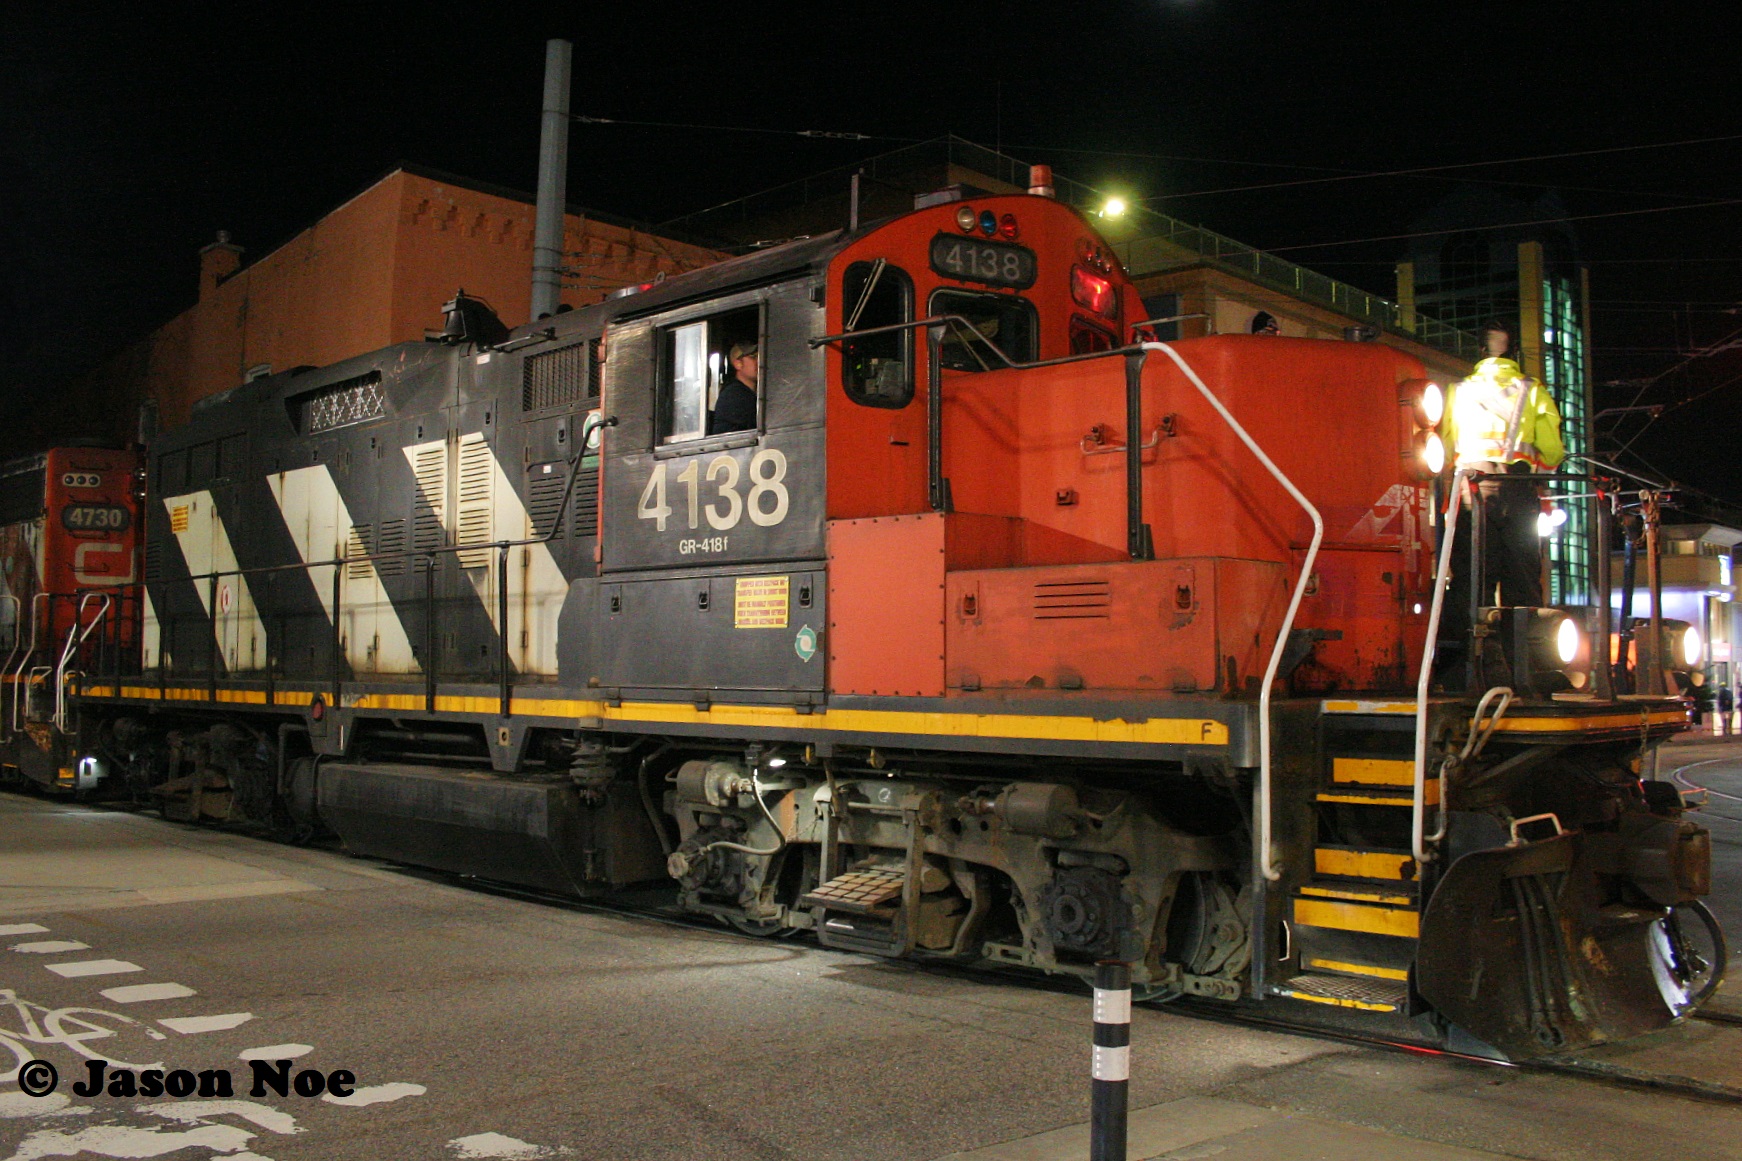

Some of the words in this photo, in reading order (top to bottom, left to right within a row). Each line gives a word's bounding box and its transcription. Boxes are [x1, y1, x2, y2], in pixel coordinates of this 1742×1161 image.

[945, 244, 1020, 281] 4138
[637, 448, 790, 532] 4138
[69, 507, 122, 528] 4730
[1201, 722, 1213, 742] F
